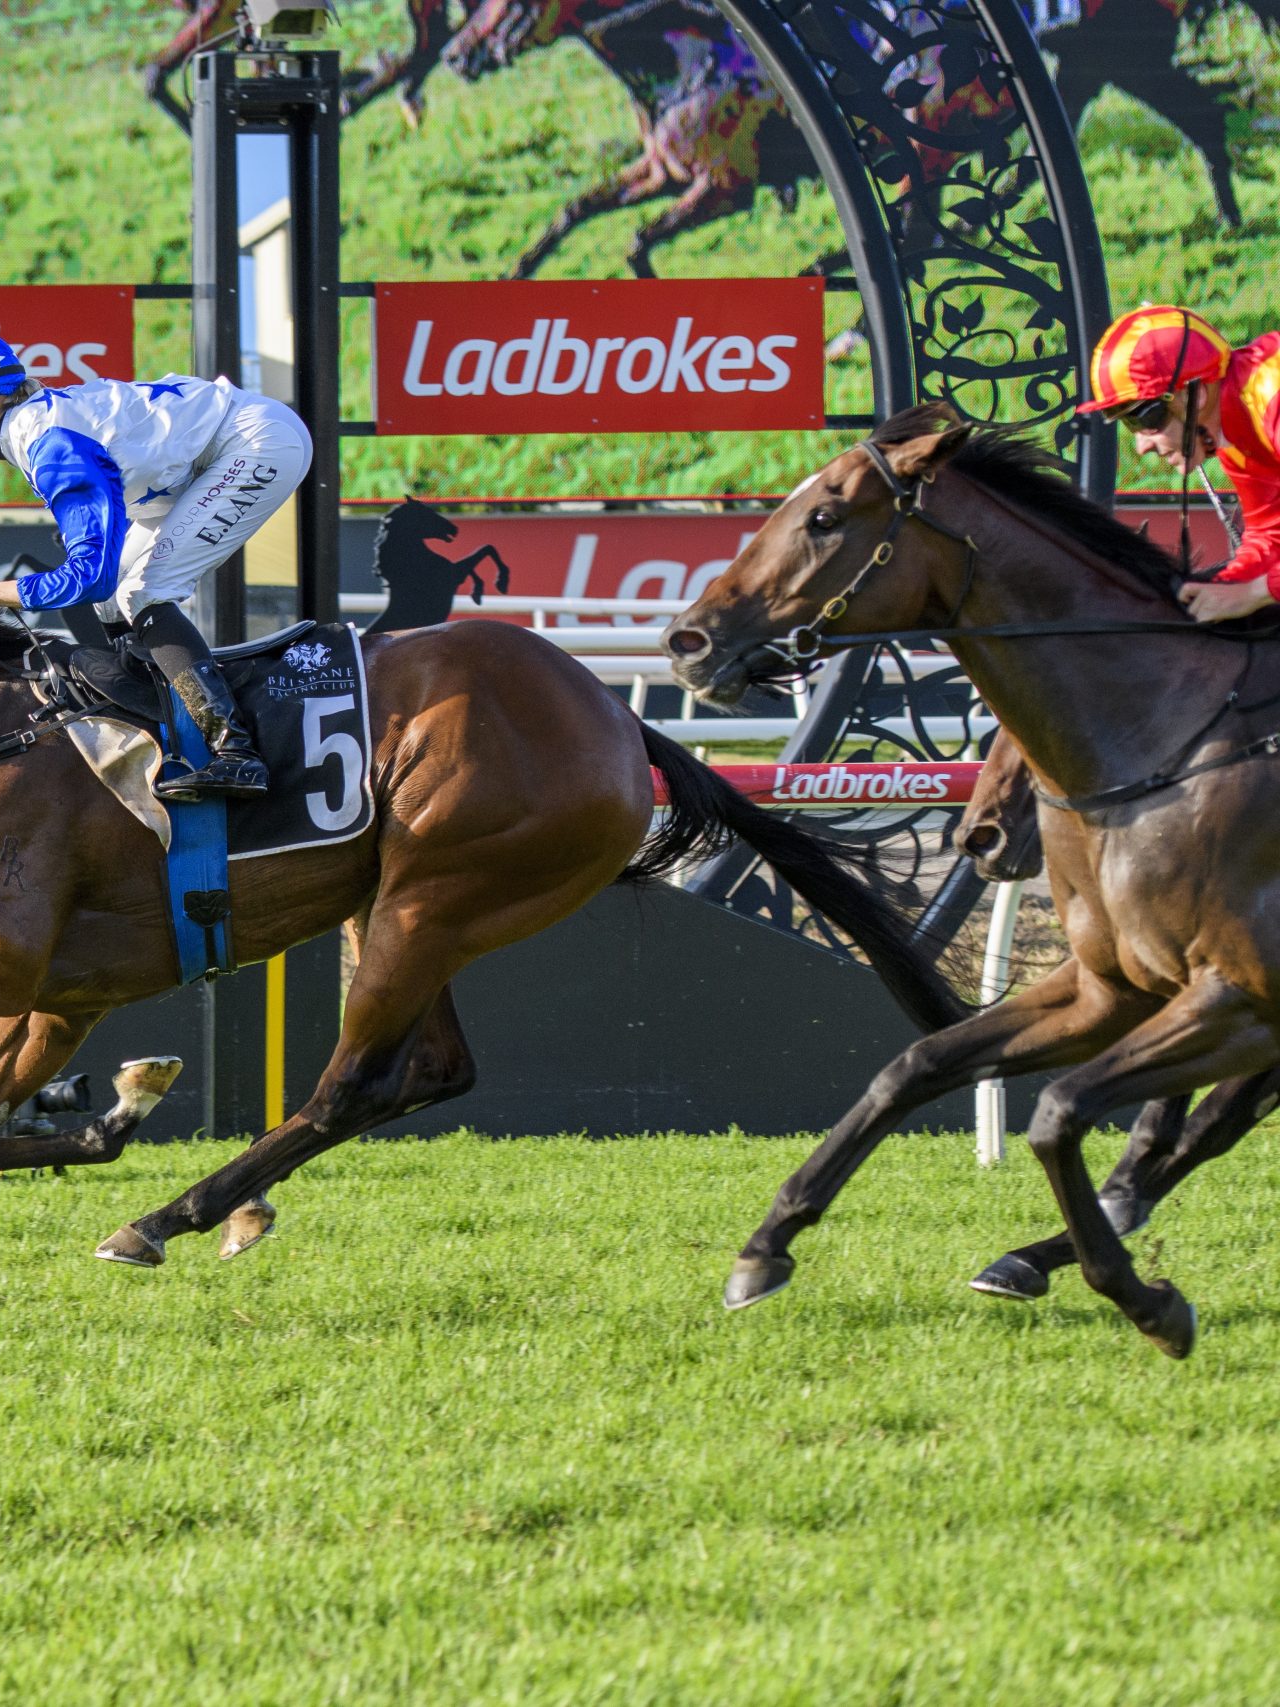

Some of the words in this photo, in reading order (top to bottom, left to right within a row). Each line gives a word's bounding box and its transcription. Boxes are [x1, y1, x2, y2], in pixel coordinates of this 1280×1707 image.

[403, 316, 797, 397] Ladbrokes
[195, 463, 278, 546] E.LANG
[268, 667, 354, 687] BRISBANE
[269, 684, 318, 698] RACING
[323, 681, 355, 690] CLUB
[303, 694, 363, 831] 5
[772, 766, 951, 799] Ladbrokes
